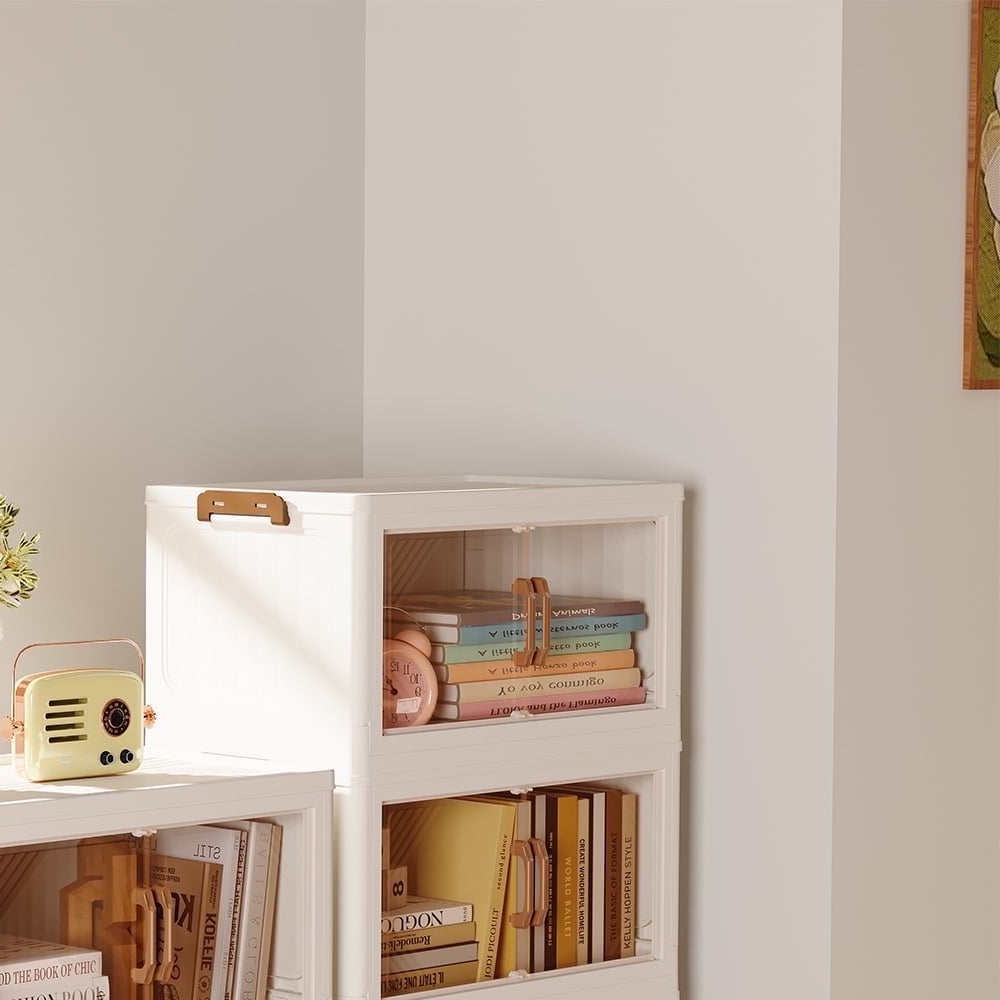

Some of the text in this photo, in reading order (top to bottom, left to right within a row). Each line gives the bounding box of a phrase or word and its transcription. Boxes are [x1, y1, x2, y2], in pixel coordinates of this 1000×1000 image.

[381, 935, 431, 951] Remodelist
[484, 907, 499, 979] JODI PICOULT
[13, 969, 31, 984] THE
[34, 966, 59, 981] BOOK
[61, 963, 73, 977] OF
[75, 960, 96, 975] CHIC
